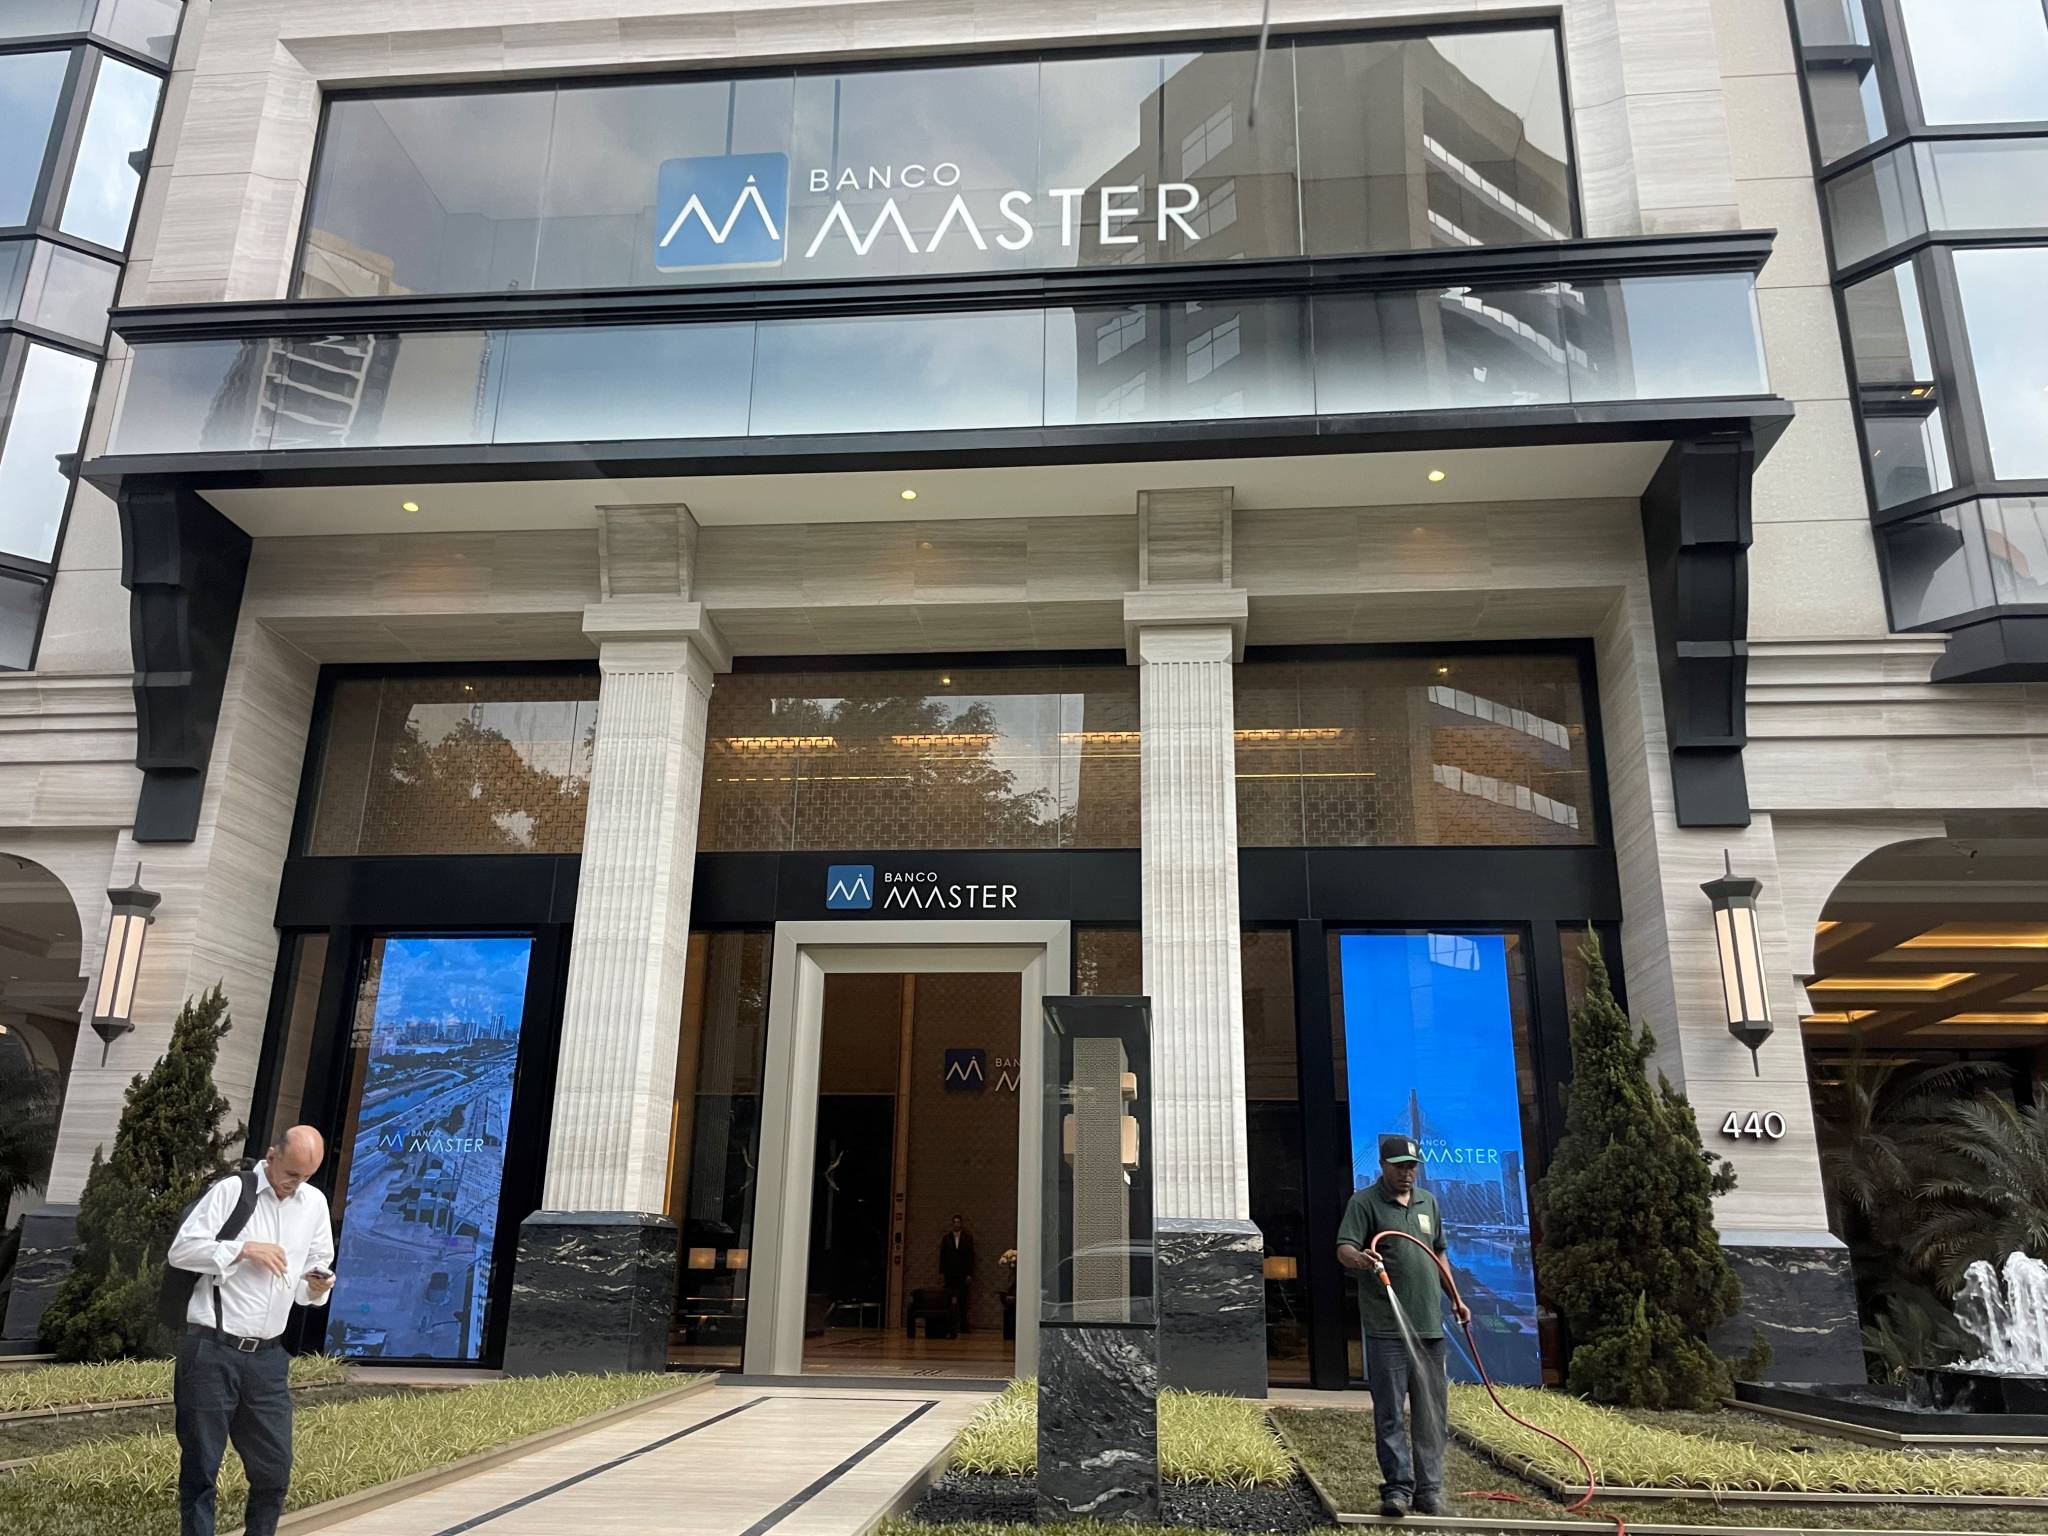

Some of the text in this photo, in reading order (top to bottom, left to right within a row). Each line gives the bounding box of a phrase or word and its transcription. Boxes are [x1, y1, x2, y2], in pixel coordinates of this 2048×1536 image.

[809, 162, 961, 192] BANCO
[804, 182, 1201, 258] MASTER
[884, 872, 938, 883] BANCO
[883, 884, 1018, 909] MASTER
[1722, 1111, 1787, 1139] 440
[409, 1138, 484, 1153] MASTER
[1418, 1148, 1498, 1164] MASTER
